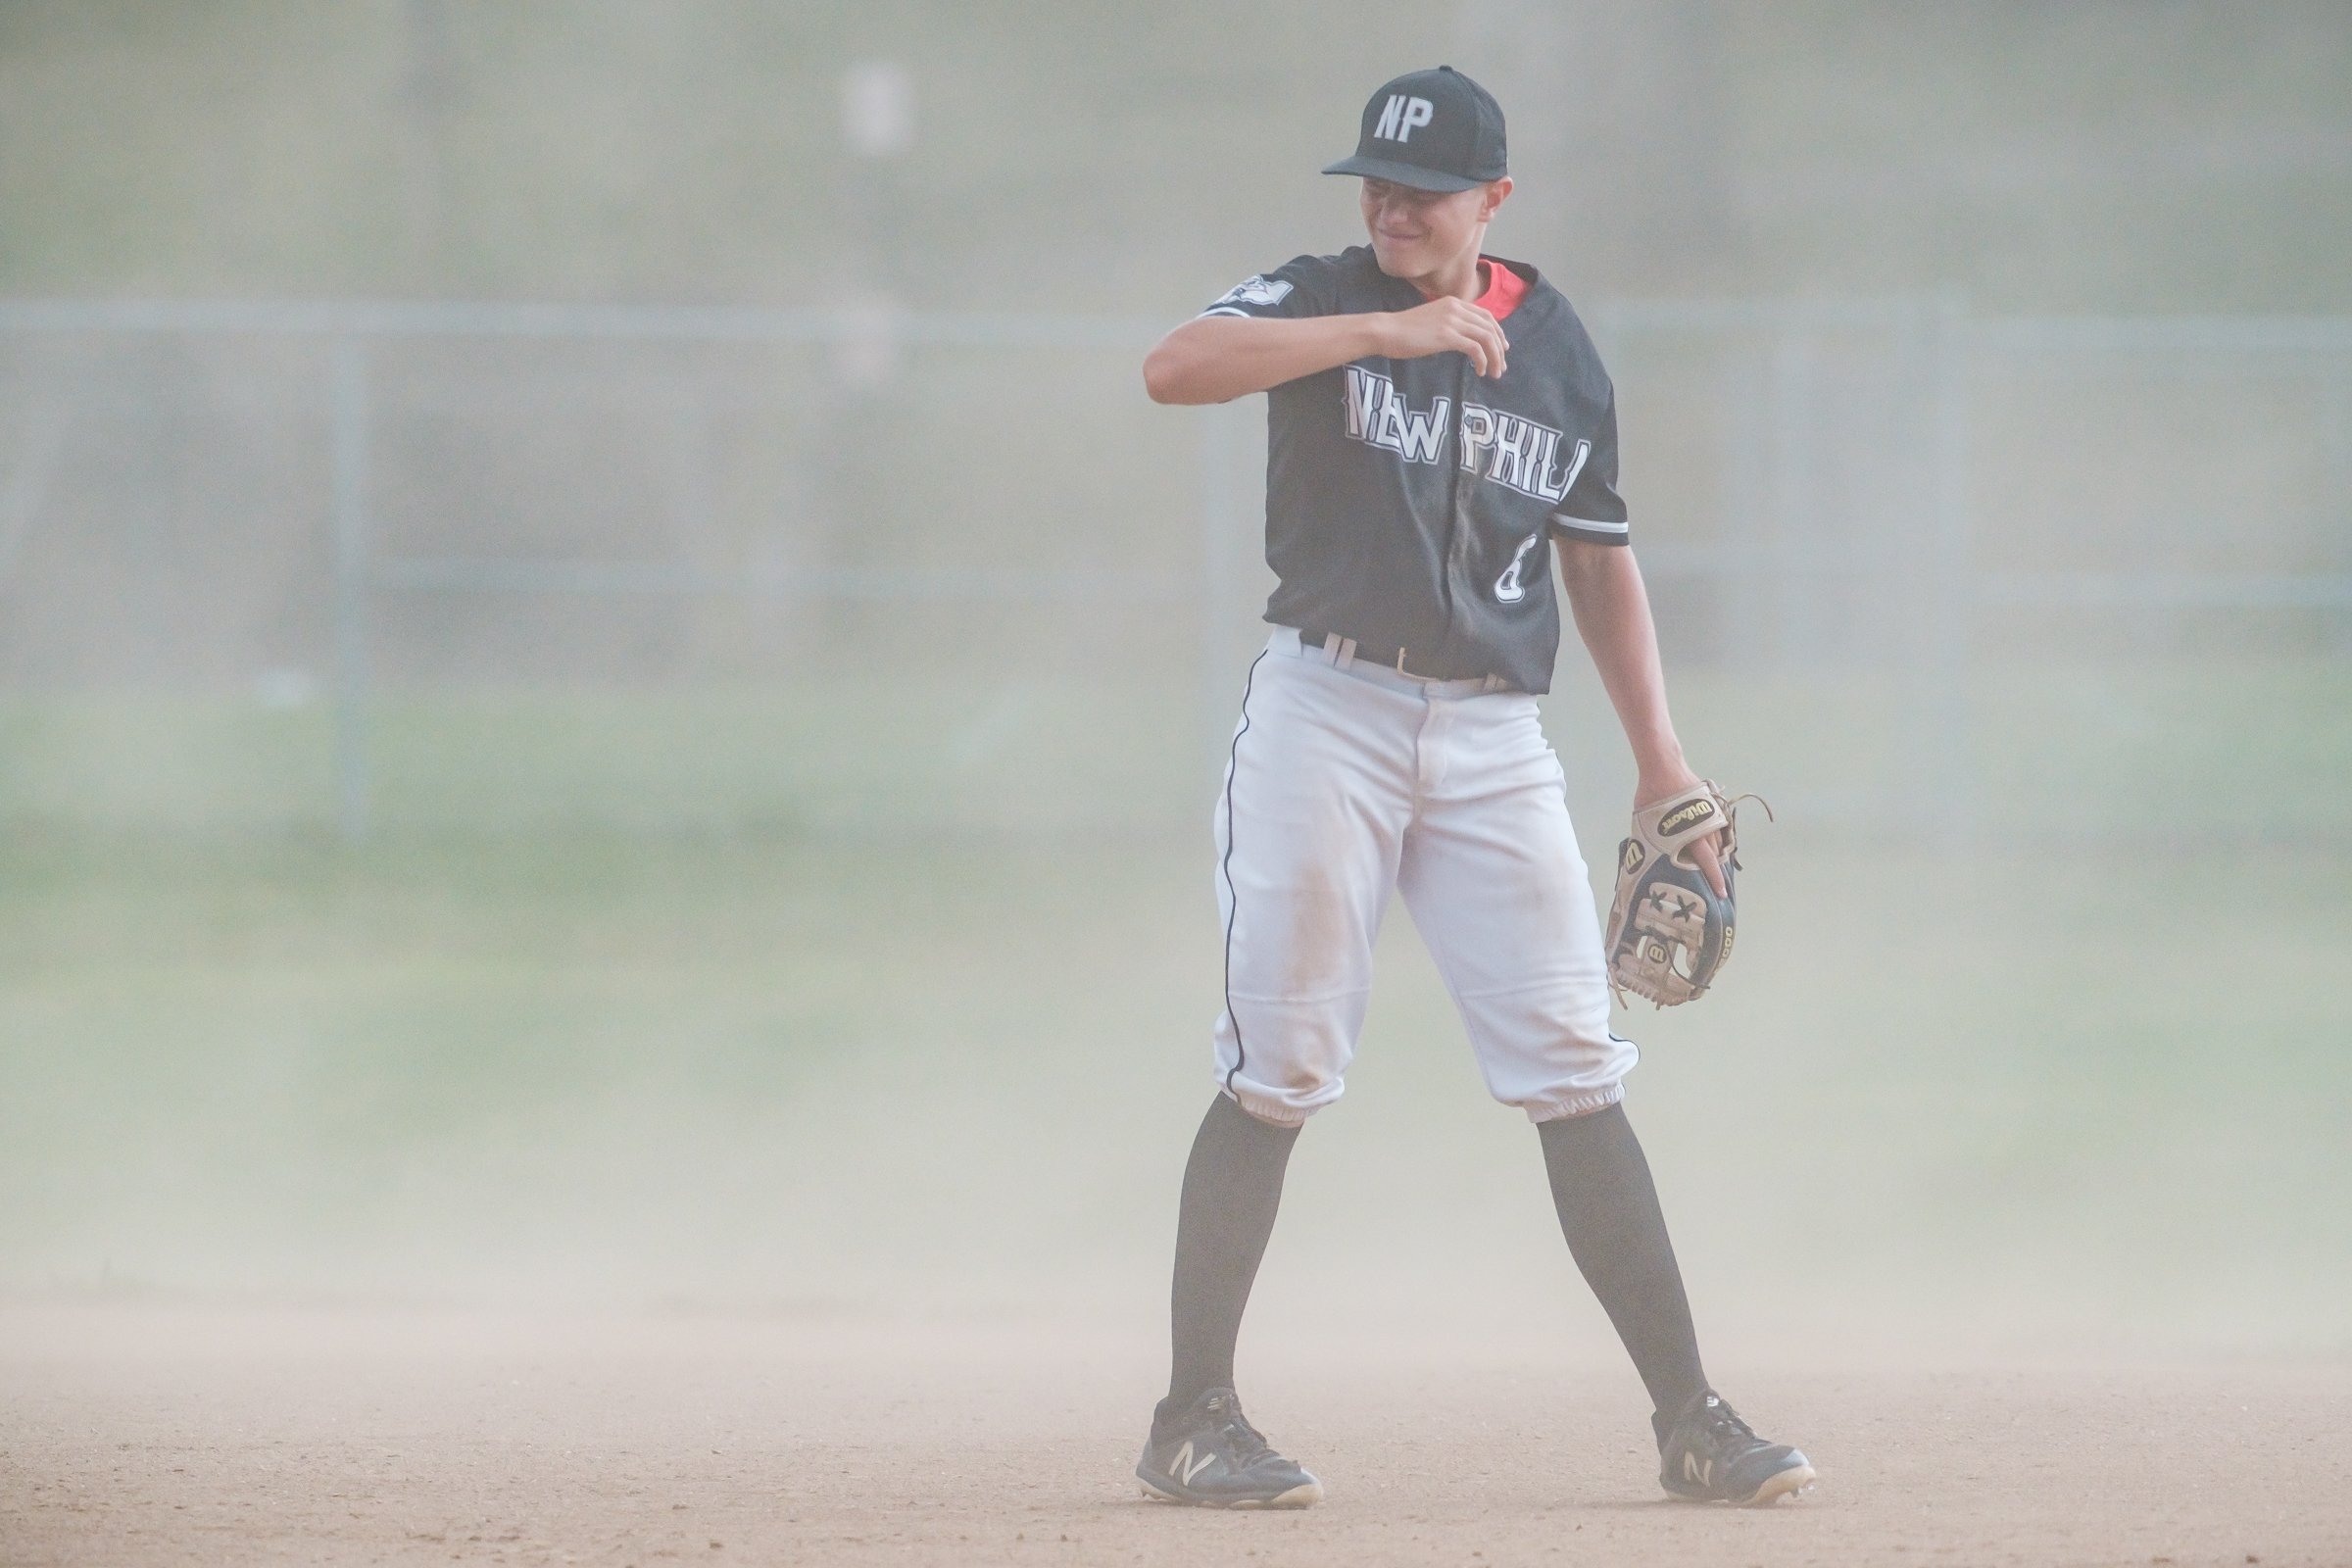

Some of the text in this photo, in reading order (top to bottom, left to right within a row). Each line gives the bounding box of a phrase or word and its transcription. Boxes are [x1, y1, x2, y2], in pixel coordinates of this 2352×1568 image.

[1373, 94, 1434, 143] NP
[1459, 401, 1592, 505] PHIL
[1662, 800, 1713, 831] Wilson
